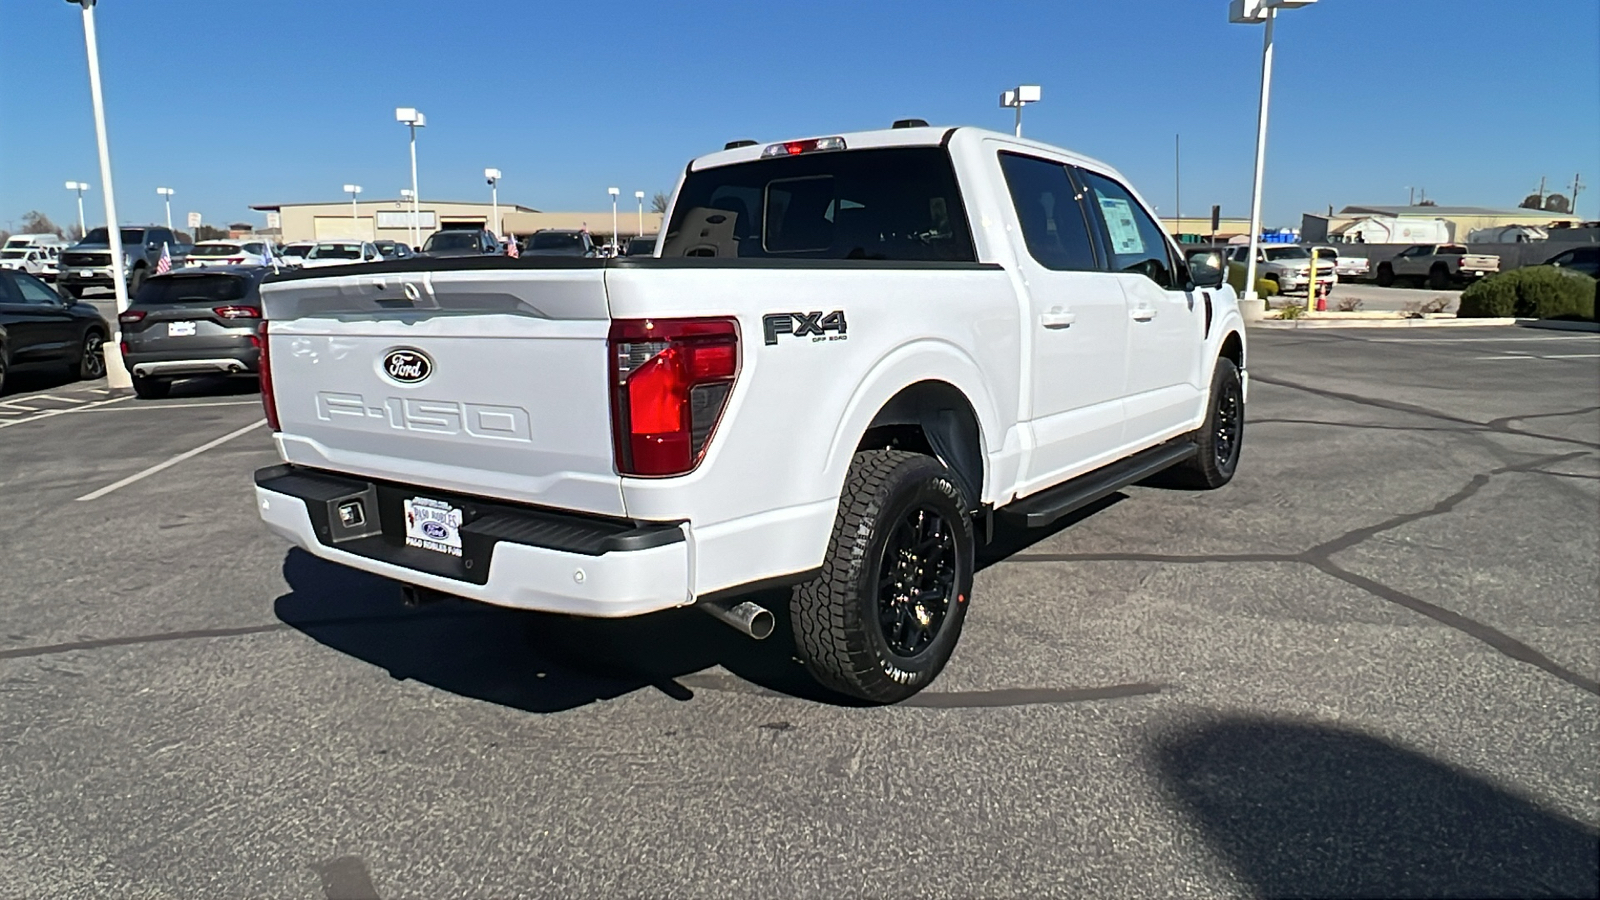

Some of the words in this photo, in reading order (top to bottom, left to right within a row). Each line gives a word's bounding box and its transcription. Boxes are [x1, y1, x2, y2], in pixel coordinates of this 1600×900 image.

[762, 310, 847, 346] FX4
[390, 354, 421, 377] Ford
[315, 390, 533, 443] F-150
